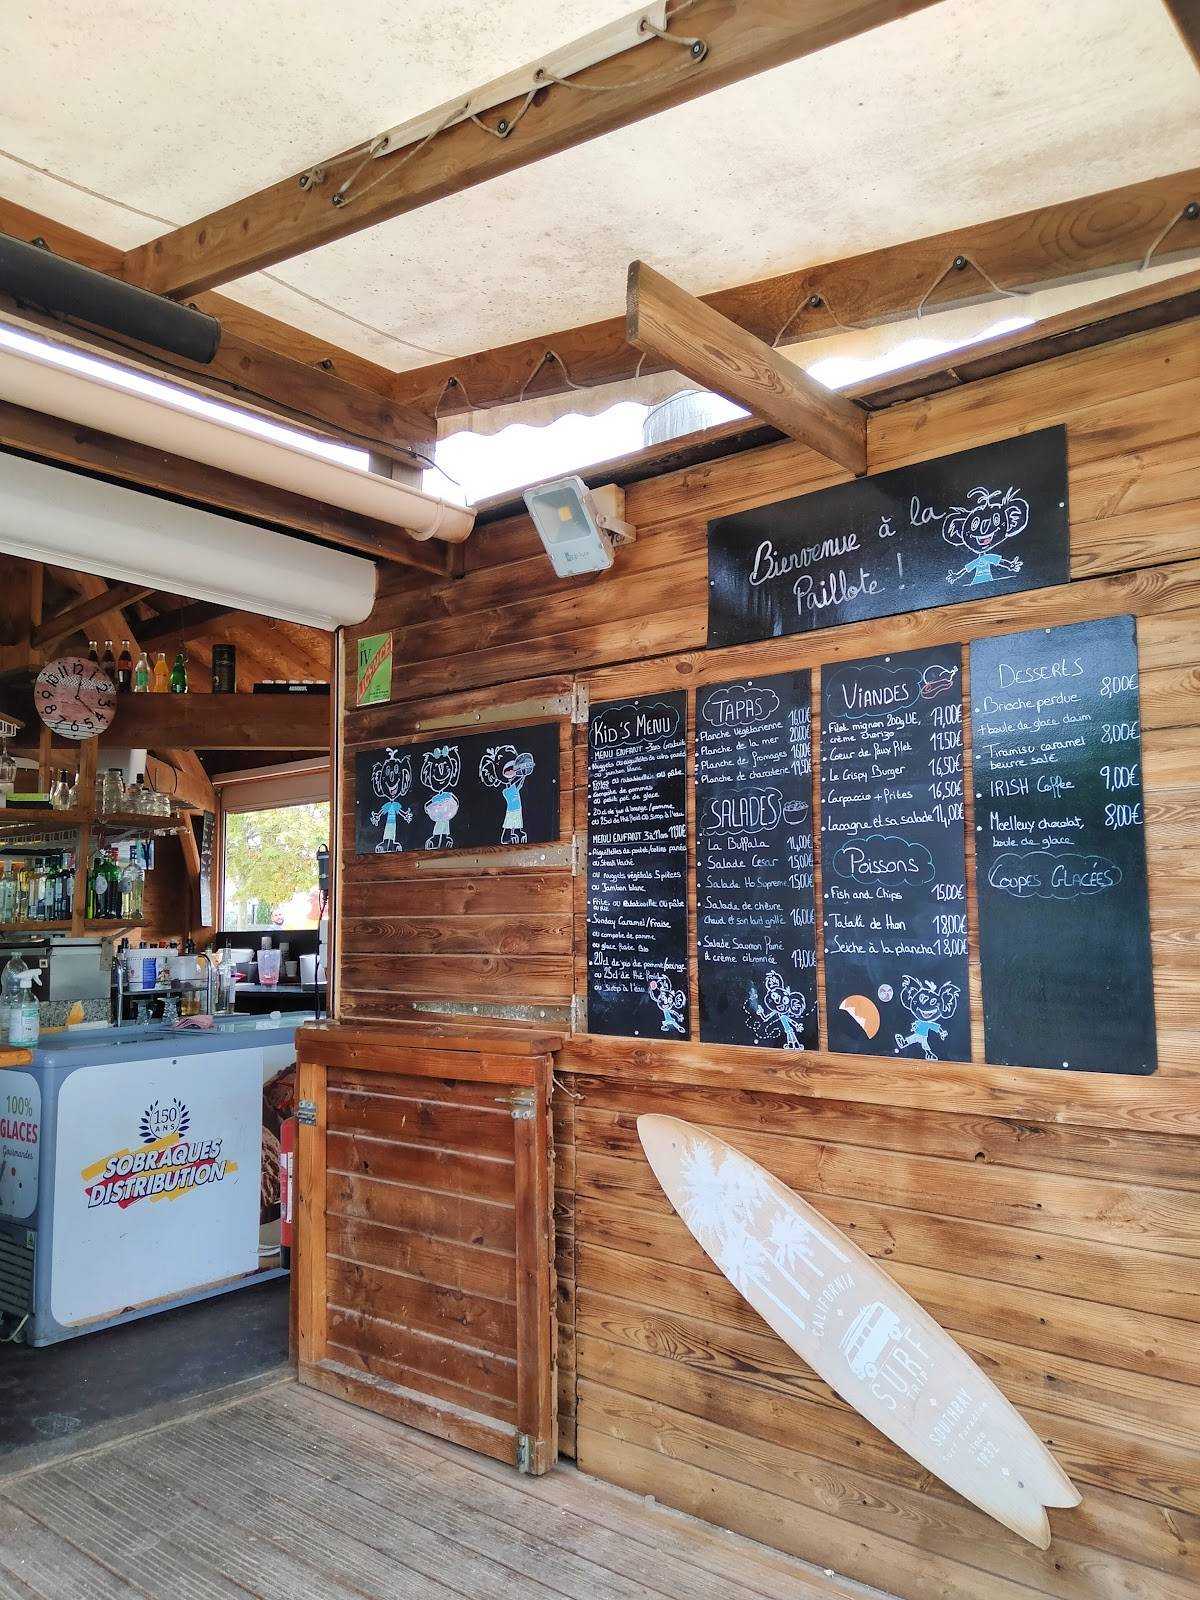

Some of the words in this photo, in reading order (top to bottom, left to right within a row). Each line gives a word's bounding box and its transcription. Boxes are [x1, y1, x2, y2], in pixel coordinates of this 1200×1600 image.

[749, 532, 861, 586] Bienvenue
[878, 515, 897, 538] à
[909, 495, 948, 526] la
[792, 568, 886, 615] Paillote
[58, 665, 69, 678] 11
[73, 662, 84, 676] 12
[89, 671, 97, 681] 1
[46, 674, 59, 688] 10
[96, 683, 108, 693] 2
[42, 690, 54, 699] 9
[98, 698, 111, 707] 3
[982, 695, 1036, 715] Brioche
[1036, 692, 1081, 713] perdue
[1099, 673, 1139, 698] 8,00€
[44, 704, 57, 714] 8
[94, 711, 106, 722] 4
[711, 697, 763, 722] TAPAS
[54, 714, 67, 725] 7
[70, 720, 79, 732] 6
[84, 718, 94, 729] 5
[700, 731, 731, 742] Planche
[788, 706, 811, 726] 16,00€
[828, 721, 849, 734] Filet
[852, 719, 884, 733] mignon
[930, 704, 963, 729] 17,00€
[1017, 719, 1031, 730] de
[1030, 716, 1060, 733] glace
[1062, 712, 1091, 725] daim
[701, 745, 733, 756] Planche
[736, 741, 747, 750] de
[749, 738, 759, 747] la
[761, 736, 780, 745] mer
[789, 724, 811, 743] 20,00€
[829, 735, 856, 745] crème
[858, 749, 871, 759] de
[929, 729, 963, 751] 19,50€
[983, 742, 1036, 759] Tiramisu
[1040, 736, 1086, 752] caramel
[1101, 721, 1141, 744] 8,00€
[594, 749, 614, 760] MENU
[615, 746, 644, 757] ENFANT
[701, 760, 734, 771] Planche
[737, 756, 749, 765] de
[751, 750, 788, 768] fromages
[790, 742, 812, 760] 16,00€
[829, 769, 839, 782] Le
[842, 770, 868, 783] Crispy
[871, 764, 906, 780] Burger
[928, 754, 963, 777] 16,50€
[990, 756, 1027, 770] beurre
[701, 775, 733, 785] Planche
[736, 772, 747, 781] de
[990, 777, 1029, 798] IRISH
[1037, 775, 1075, 798] Coffee
[1100, 764, 1139, 792] 9,00€
[928, 779, 964, 801] 16,50€
[706, 793, 777, 830] SALADES
[885, 817, 899, 828] sa
[899, 811, 933, 824] salade
[990, 811, 1035, 833] Moelleux
[1104, 803, 1143, 830] 8,00€
[708, 838, 722, 851] La
[786, 833, 813, 852] 14,00€
[992, 836, 1018, 847] boule
[1021, 836, 1040, 846] de
[1042, 835, 1075, 850] glace
[706, 855, 746, 870] Salade
[787, 852, 814, 870] 15,00€
[842, 846, 919, 874] Poissons
[628, 884, 646, 892] blanc
[705, 875, 741, 889] Salade
[788, 872, 815, 891] 15,00€
[830, 885, 850, 900] Fish
[852, 890, 873, 899] and
[876, 887, 903, 901] Chips
[931, 883, 965, 901] 15,00€
[704, 895, 741, 911] Salade
[741, 901, 753, 910] de
[754, 901, 784, 911] chèvre
[592, 912, 616, 929] Sunday
[736, 916, 748, 925] son
[789, 907, 815, 927] 16,00€
[870, 918, 882, 930] de
[932, 914, 967, 938] 18,00€
[703, 935, 730, 949] Salade
[732, 937, 762, 951] Saumon
[830, 934, 867, 954] Seiche
[868, 942, 879, 953] à
[880, 940, 894, 953] la
[894, 942, 936, 956] plancha
[933, 938, 969, 958] 18,00€
[712, 953, 738, 963] crème
[791, 949, 817, 970] 17,00€
[6, 1095, 33, 1117] 100%
[153, 1108, 178, 1124] 150
[0, 1119, 38, 1144] GLACES
[155, 1124, 176, 1133] ANS
[102, 1138, 223, 1179] SOBRAQUES
[88, 1160, 227, 1208] DISTRIBUTION
[810, 1273, 856, 1337] CALIFORNIA
[871, 1327, 929, 1410] SURF
[929, 1387, 972, 1447] SOUTHBAY
